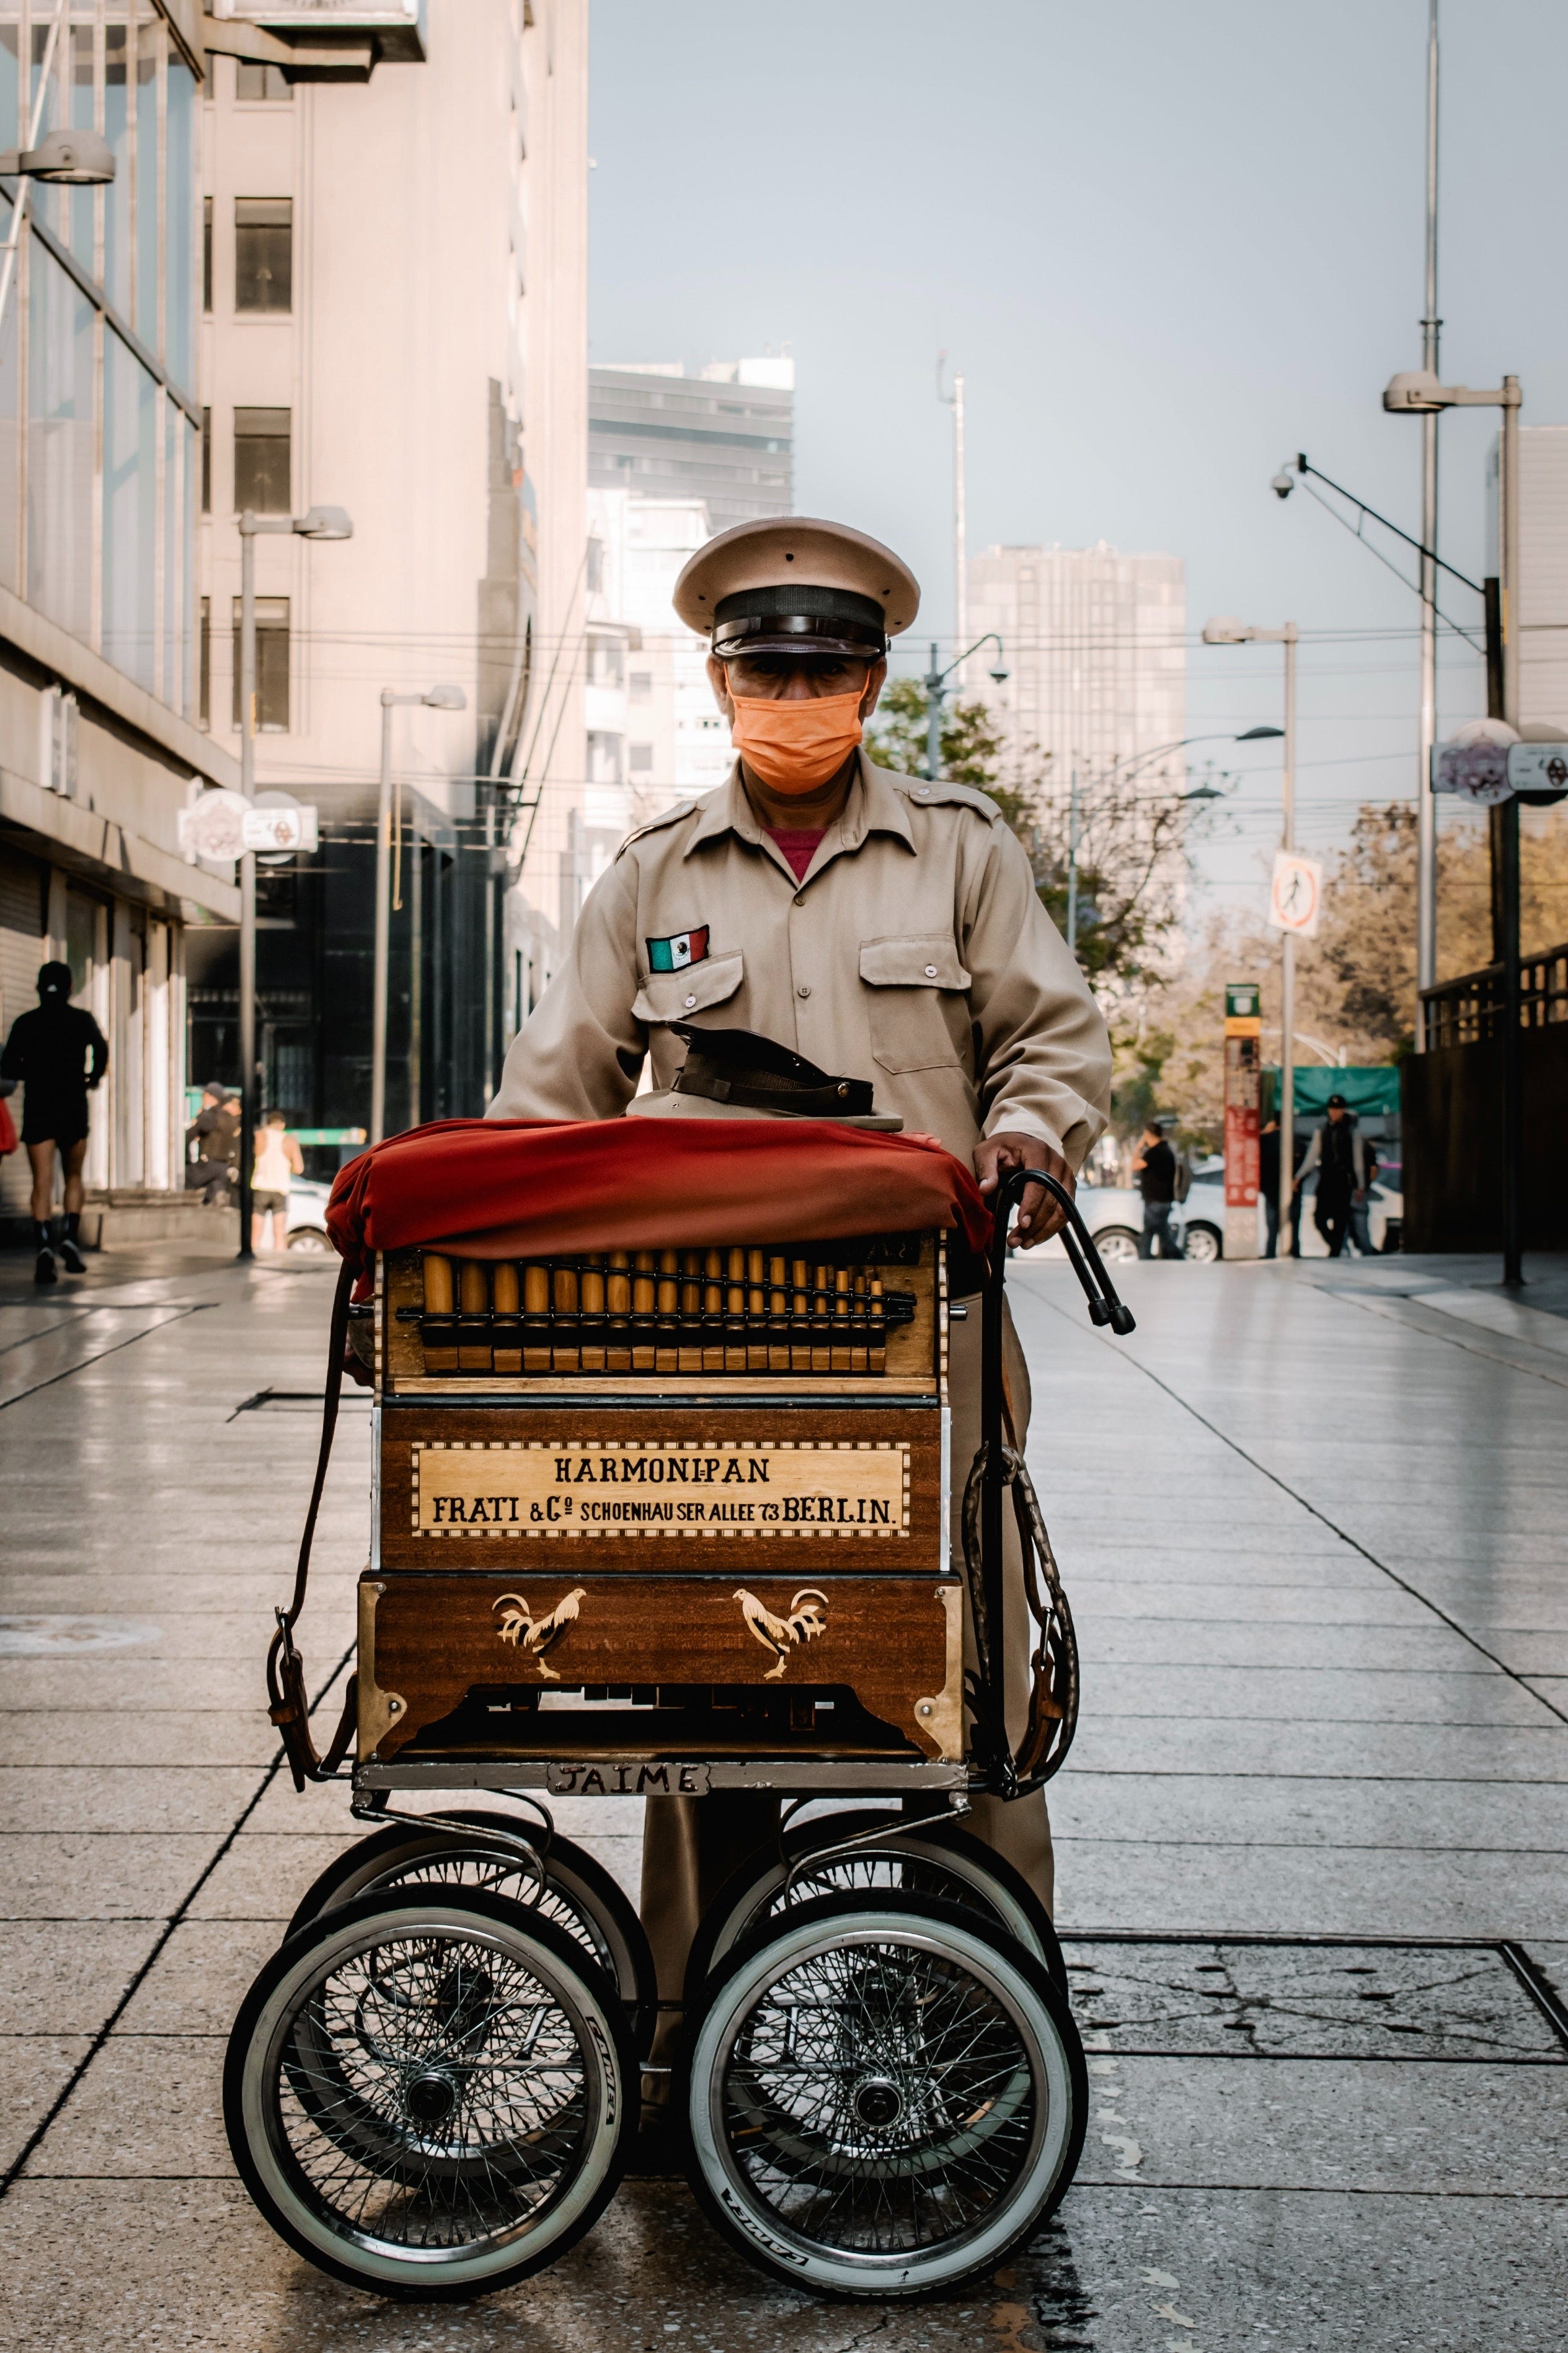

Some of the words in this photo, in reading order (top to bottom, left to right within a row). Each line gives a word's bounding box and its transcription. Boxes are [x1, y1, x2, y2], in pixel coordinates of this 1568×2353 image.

[432, 1496, 520, 1523] FRATI
[708, 1503, 755, 1521] ALLEE
[758, 1503, 779, 1521] 73
[782, 1497, 897, 1524] BERLIN.
[555, 1764, 699, 1794] JAIME
[586, 2017, 616, 2124] CAMEL
[722, 2188, 808, 2266] CAMEL
